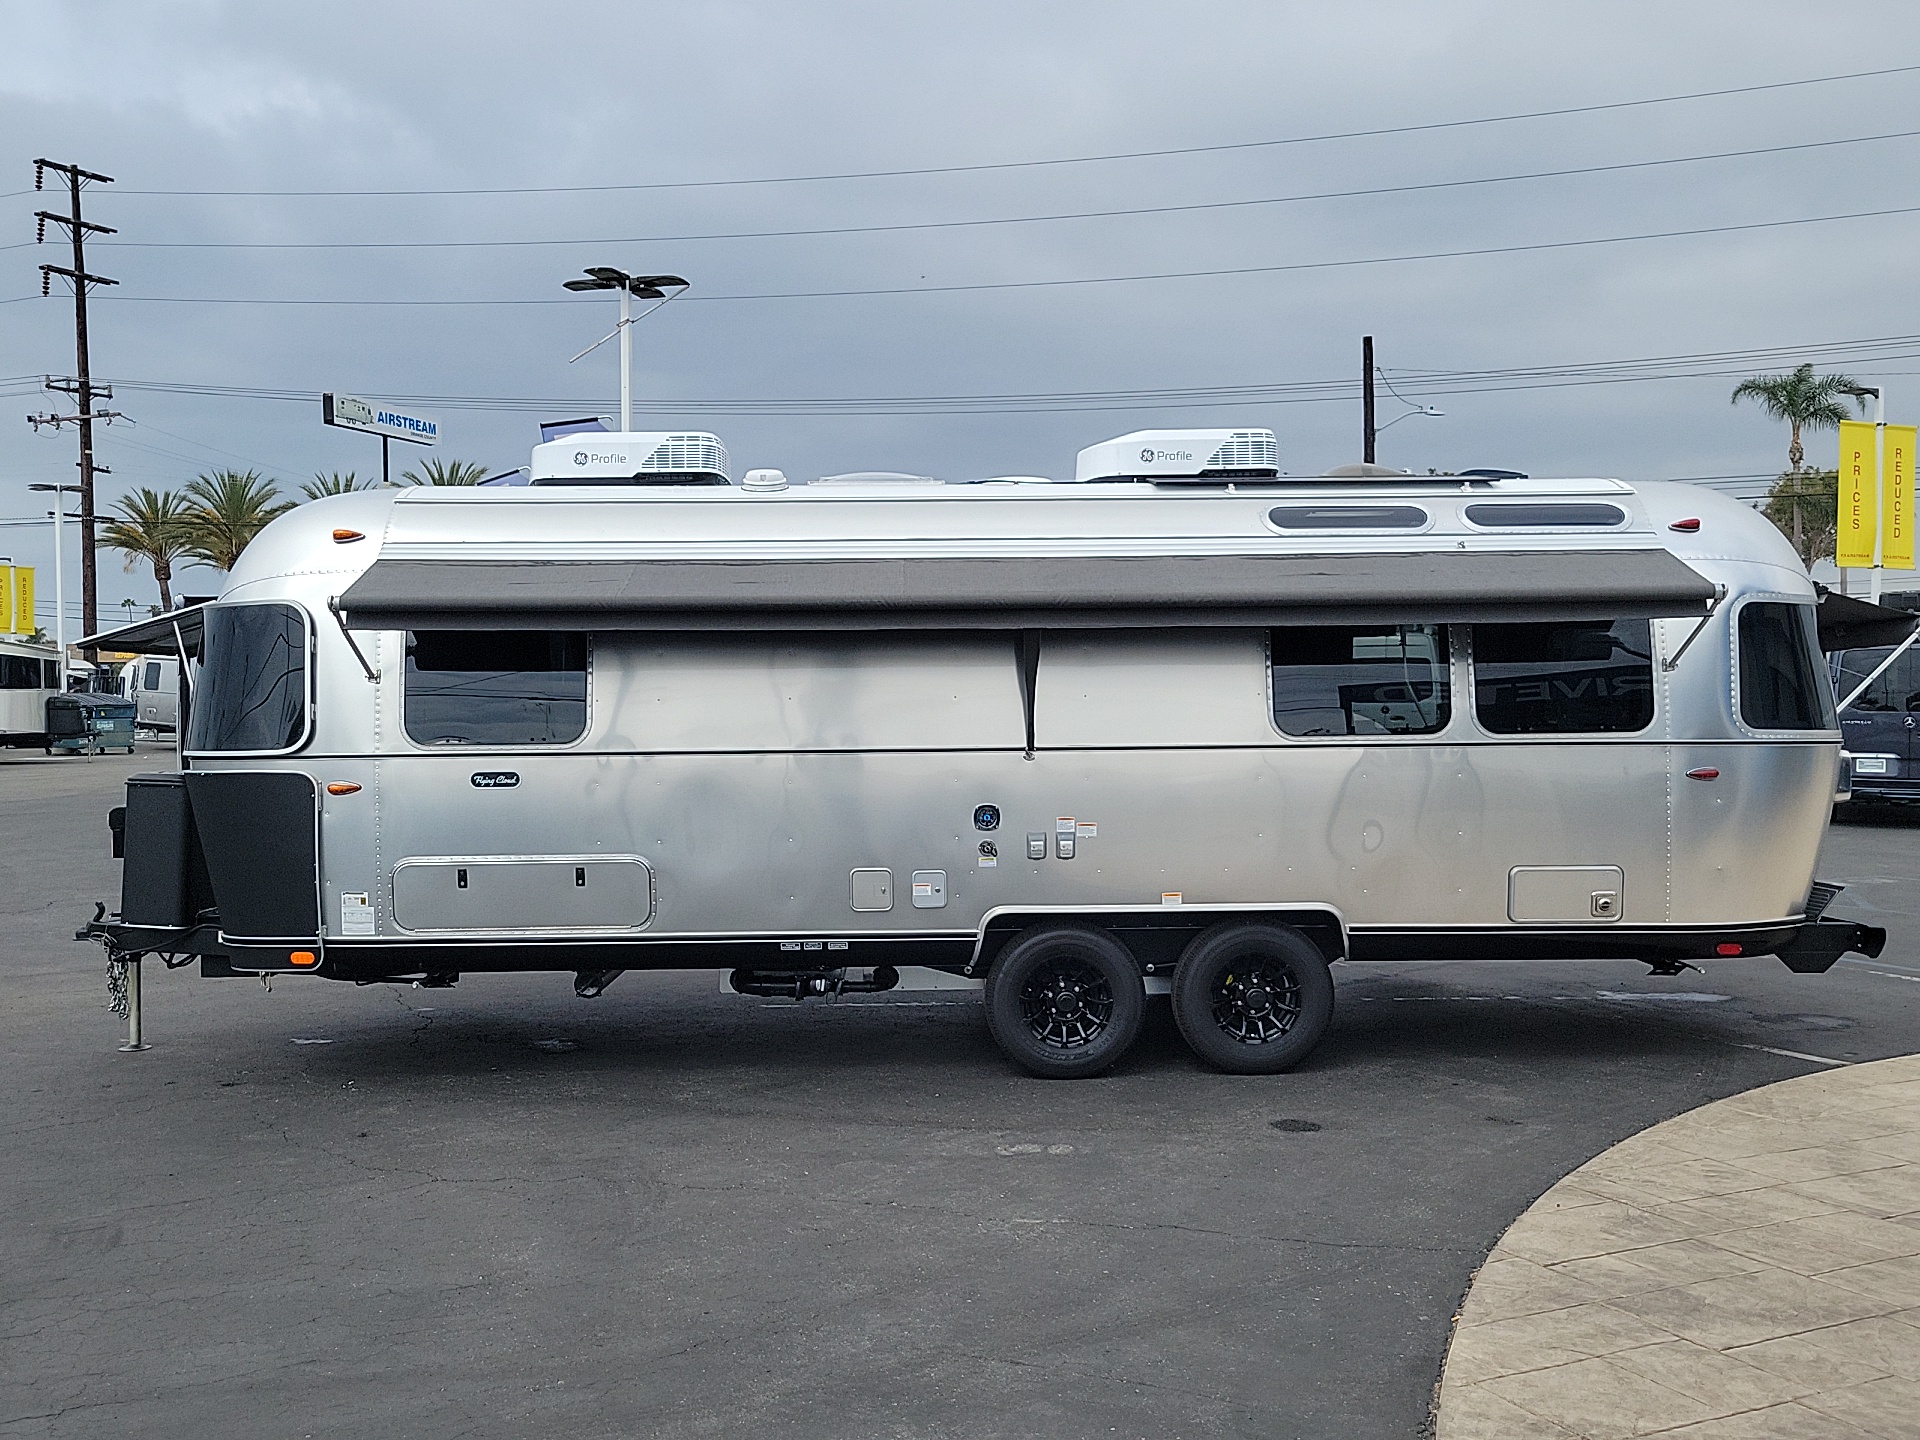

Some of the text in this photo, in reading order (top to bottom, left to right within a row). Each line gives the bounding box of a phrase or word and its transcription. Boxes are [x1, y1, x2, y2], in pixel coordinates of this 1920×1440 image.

[377, 411, 437, 435] AIRSTREAM
[591, 453, 627, 464] Profile
[1157, 450, 1192, 461] Profile
[1852, 452, 1861, 530] PRICES
[1893, 448, 1902, 539] REDUCED
[473, 775, 518, 787] Flying Cloud
